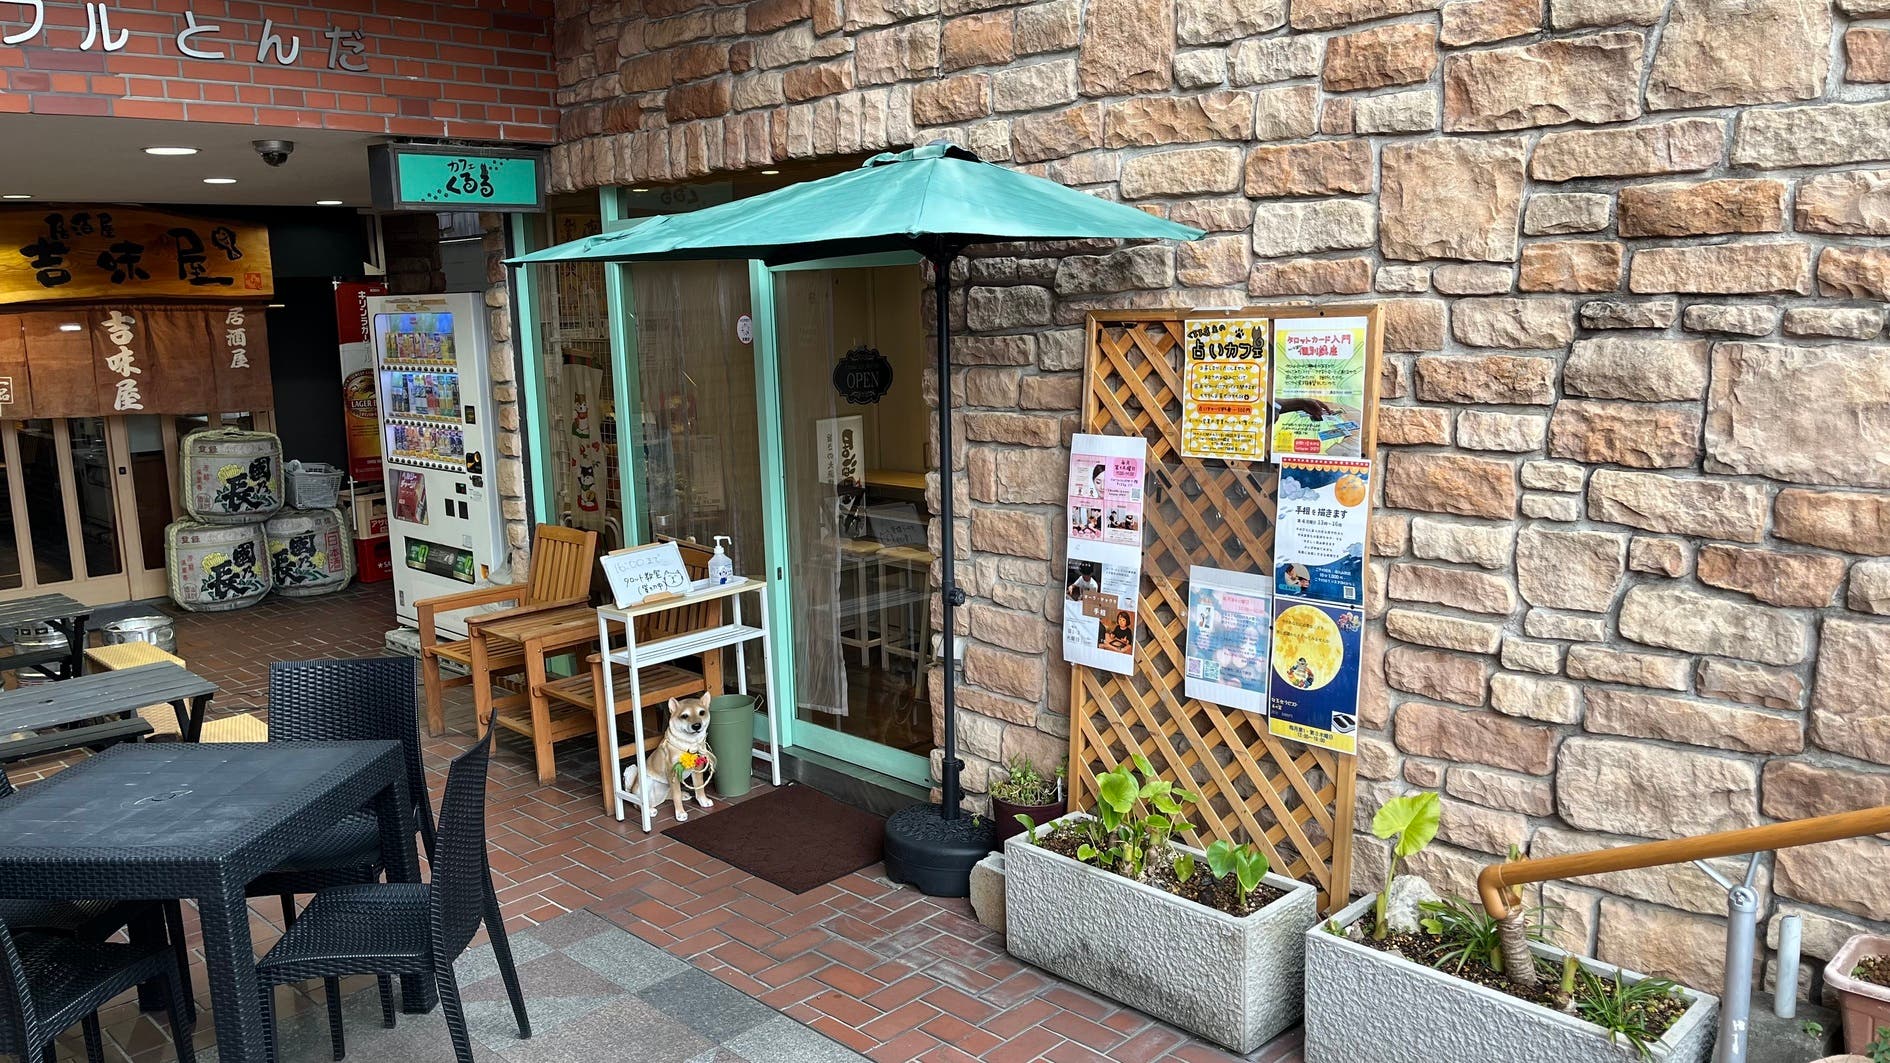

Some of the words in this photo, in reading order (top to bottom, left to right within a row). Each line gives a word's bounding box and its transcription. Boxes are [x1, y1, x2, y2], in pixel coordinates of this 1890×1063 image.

[447, 159, 476, 172] カフェ
[446, 168, 494, 198] くるる
[44, 212, 116, 240] 居酒屋
[19, 225, 235, 288] 吉味屋
[225, 306, 250, 369] 居酒屋
[1192, 338, 1264, 360] 占いカフェ
[101, 310, 145, 411] 吉味屋
[846, 371, 879, 389] OPEN
[351, 399, 373, 409] LAGER
[1295, 505, 1348, 520] 手相を描きます
[327, 535, 341, 571] 日本酒
